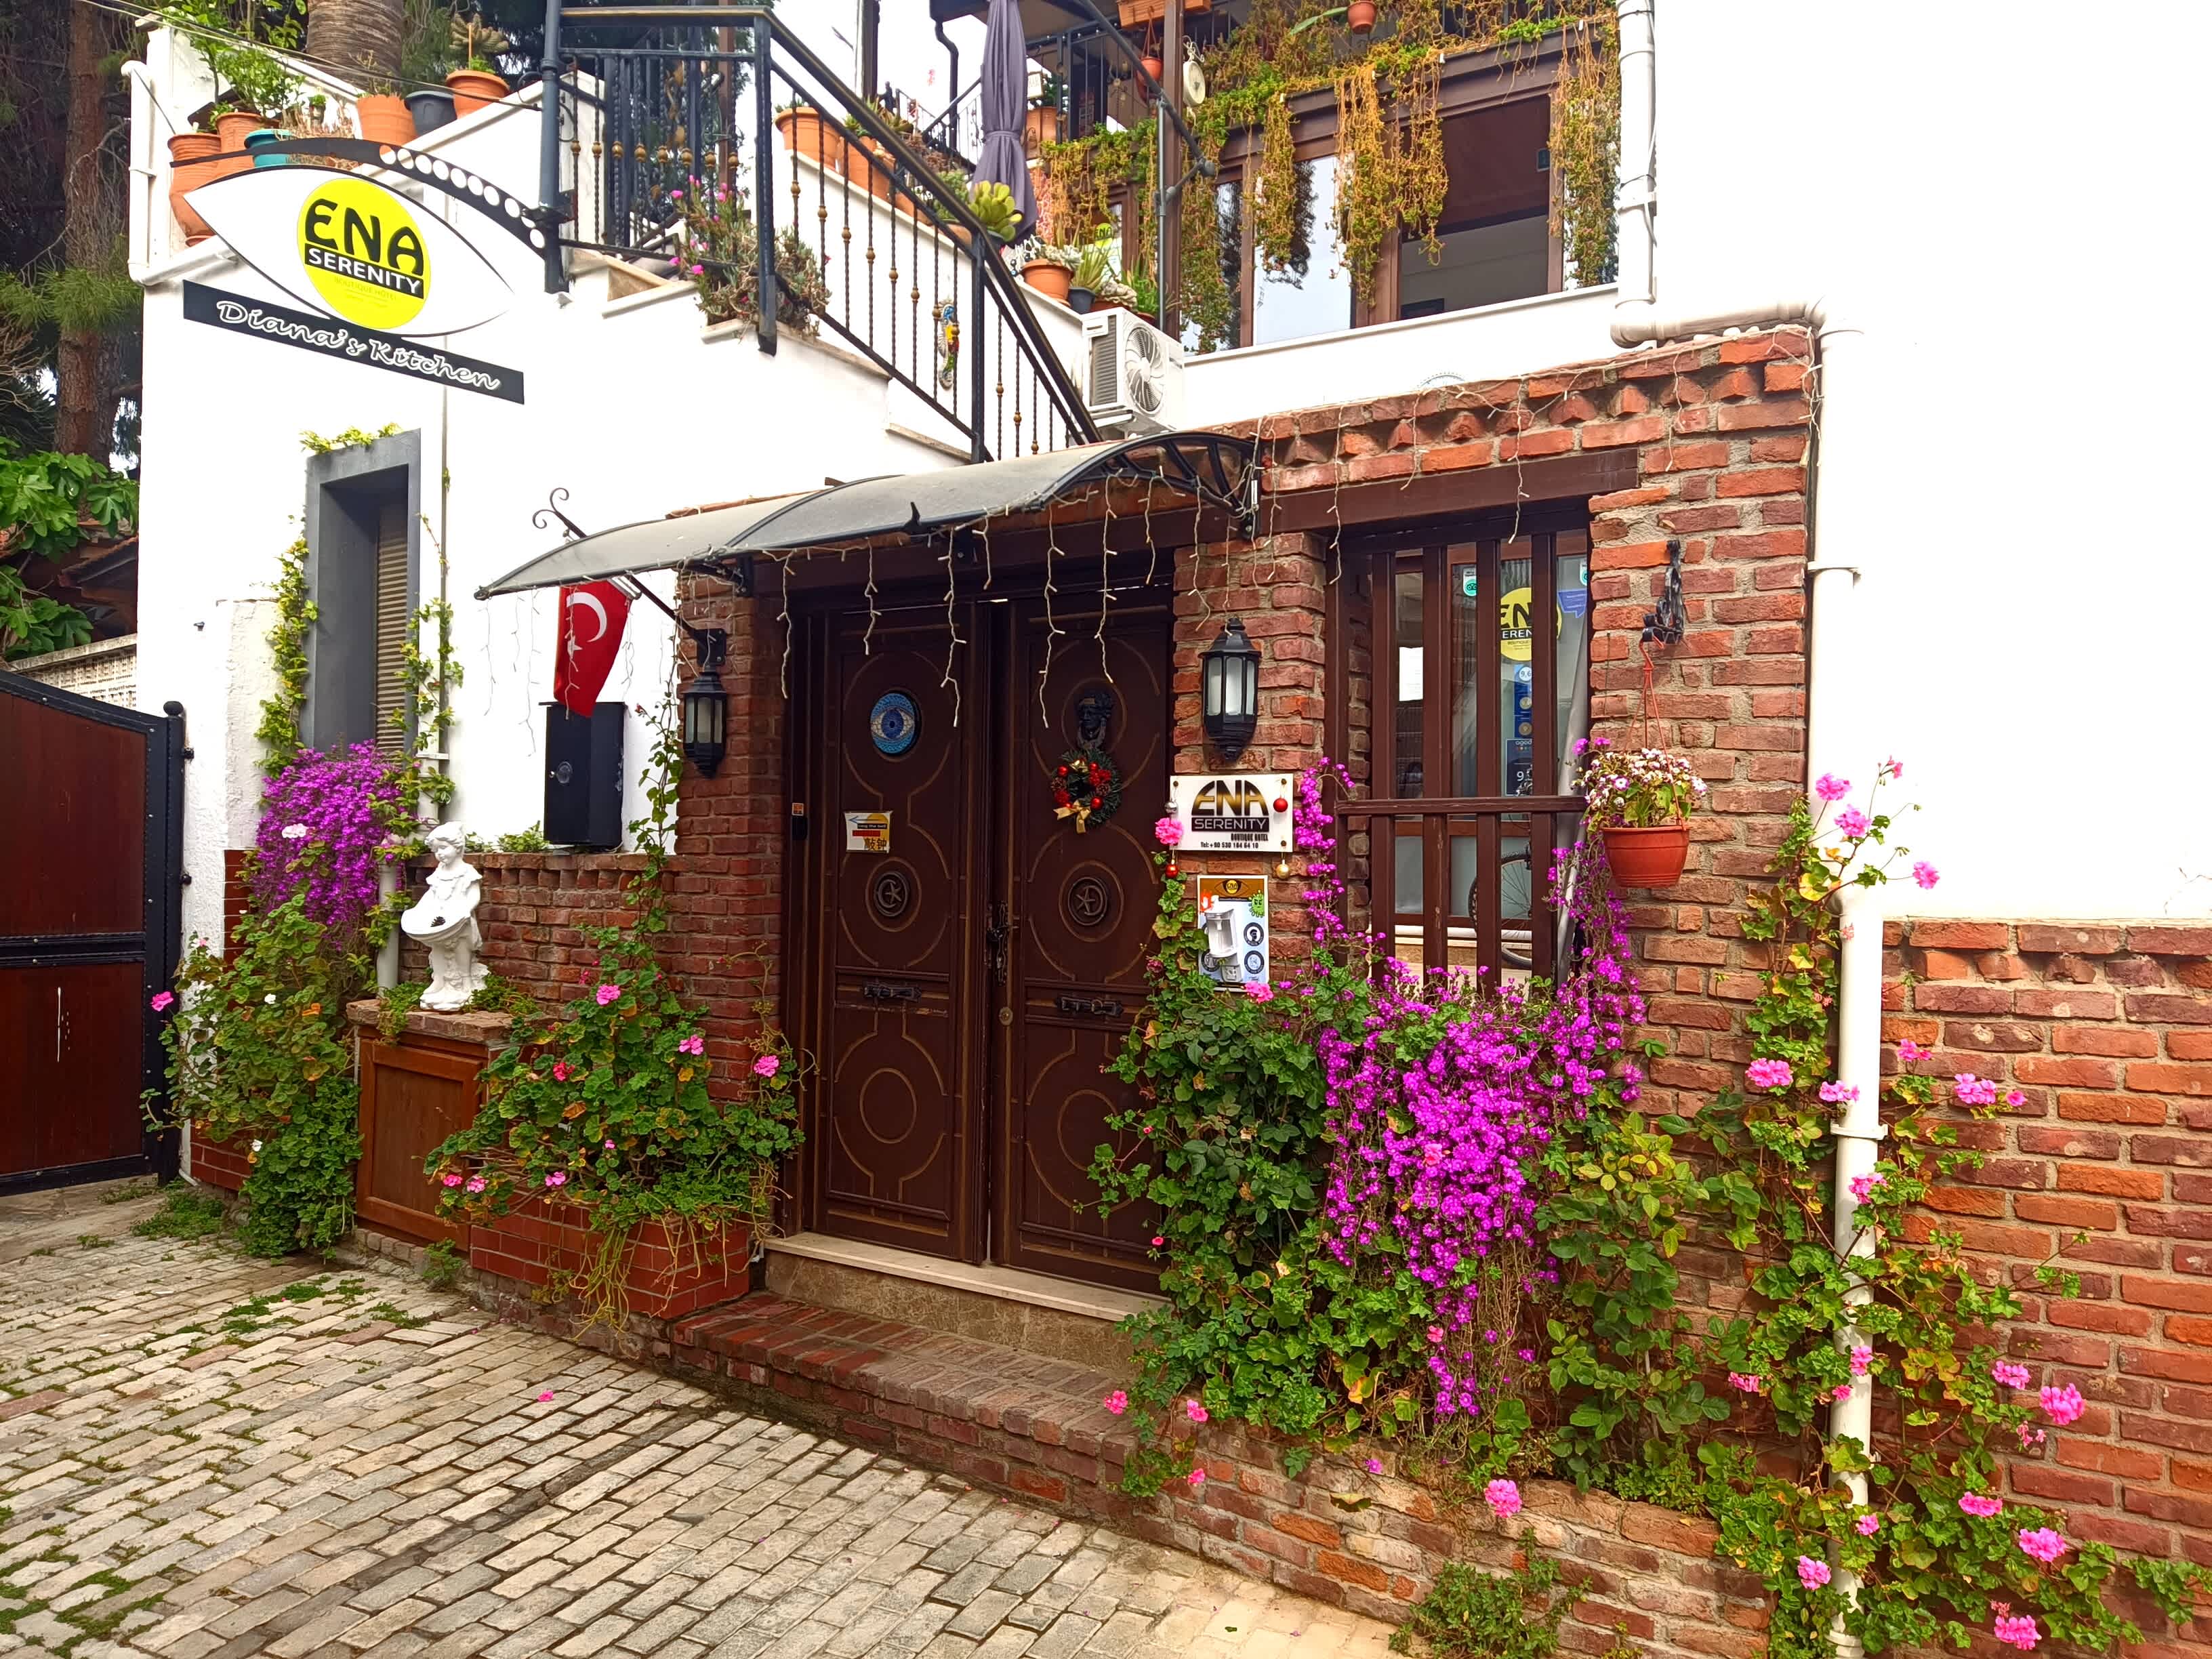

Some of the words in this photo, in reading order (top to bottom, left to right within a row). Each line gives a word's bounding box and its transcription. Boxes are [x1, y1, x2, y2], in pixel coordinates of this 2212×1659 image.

[305, 198, 424, 276] ENA
[308, 247, 420, 294] SERENITY
[217, 300, 367, 356] Diana's
[369, 339, 501, 390] Kitchen
[1502, 630, 1532, 639] EREN
[1515, 738, 1532, 746] agod
[1191, 780, 1269, 816] ENA
[1194, 818, 1266, 830] SERENITY
[1231, 833, 1253, 841] BOUTIQUE
